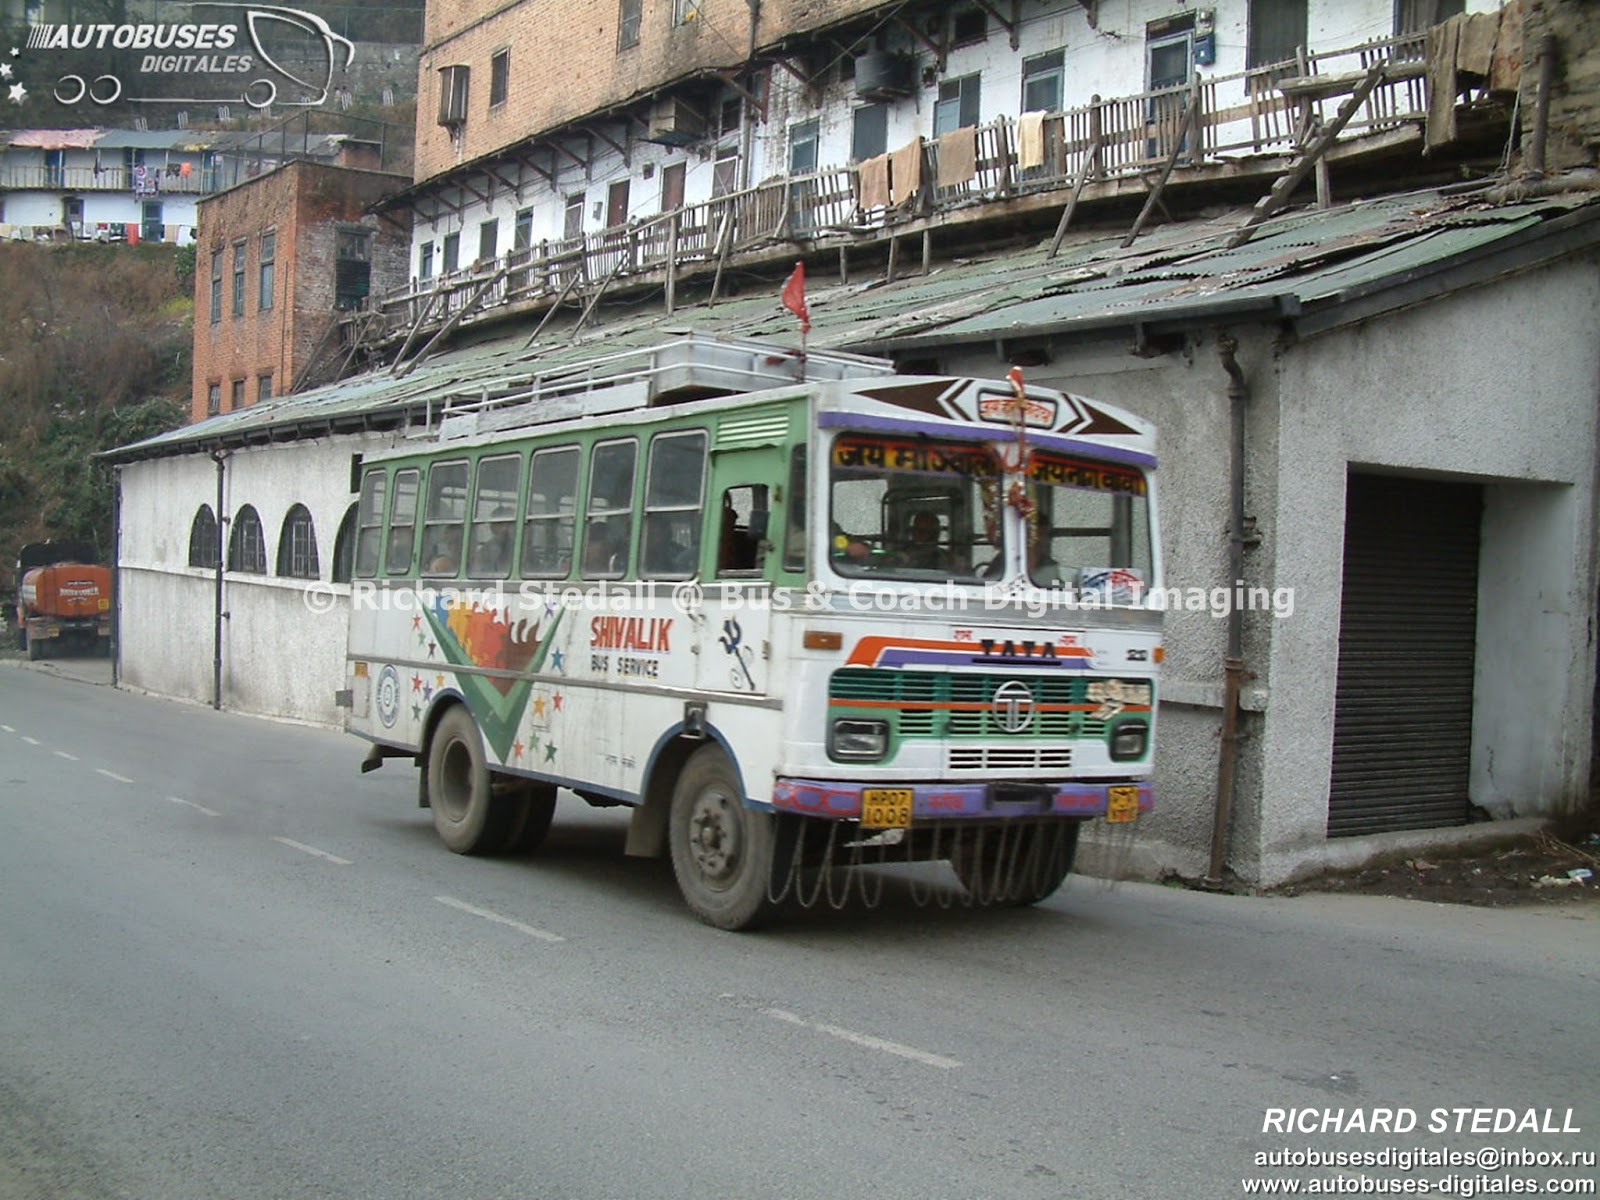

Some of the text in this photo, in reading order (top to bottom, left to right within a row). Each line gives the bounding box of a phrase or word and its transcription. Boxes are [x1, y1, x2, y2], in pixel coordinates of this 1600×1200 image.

[590, 615, 673, 651] SHIVALIK
[981, 639, 1056, 658] TATA
[591, 654, 659, 677] BUS SERVICE
